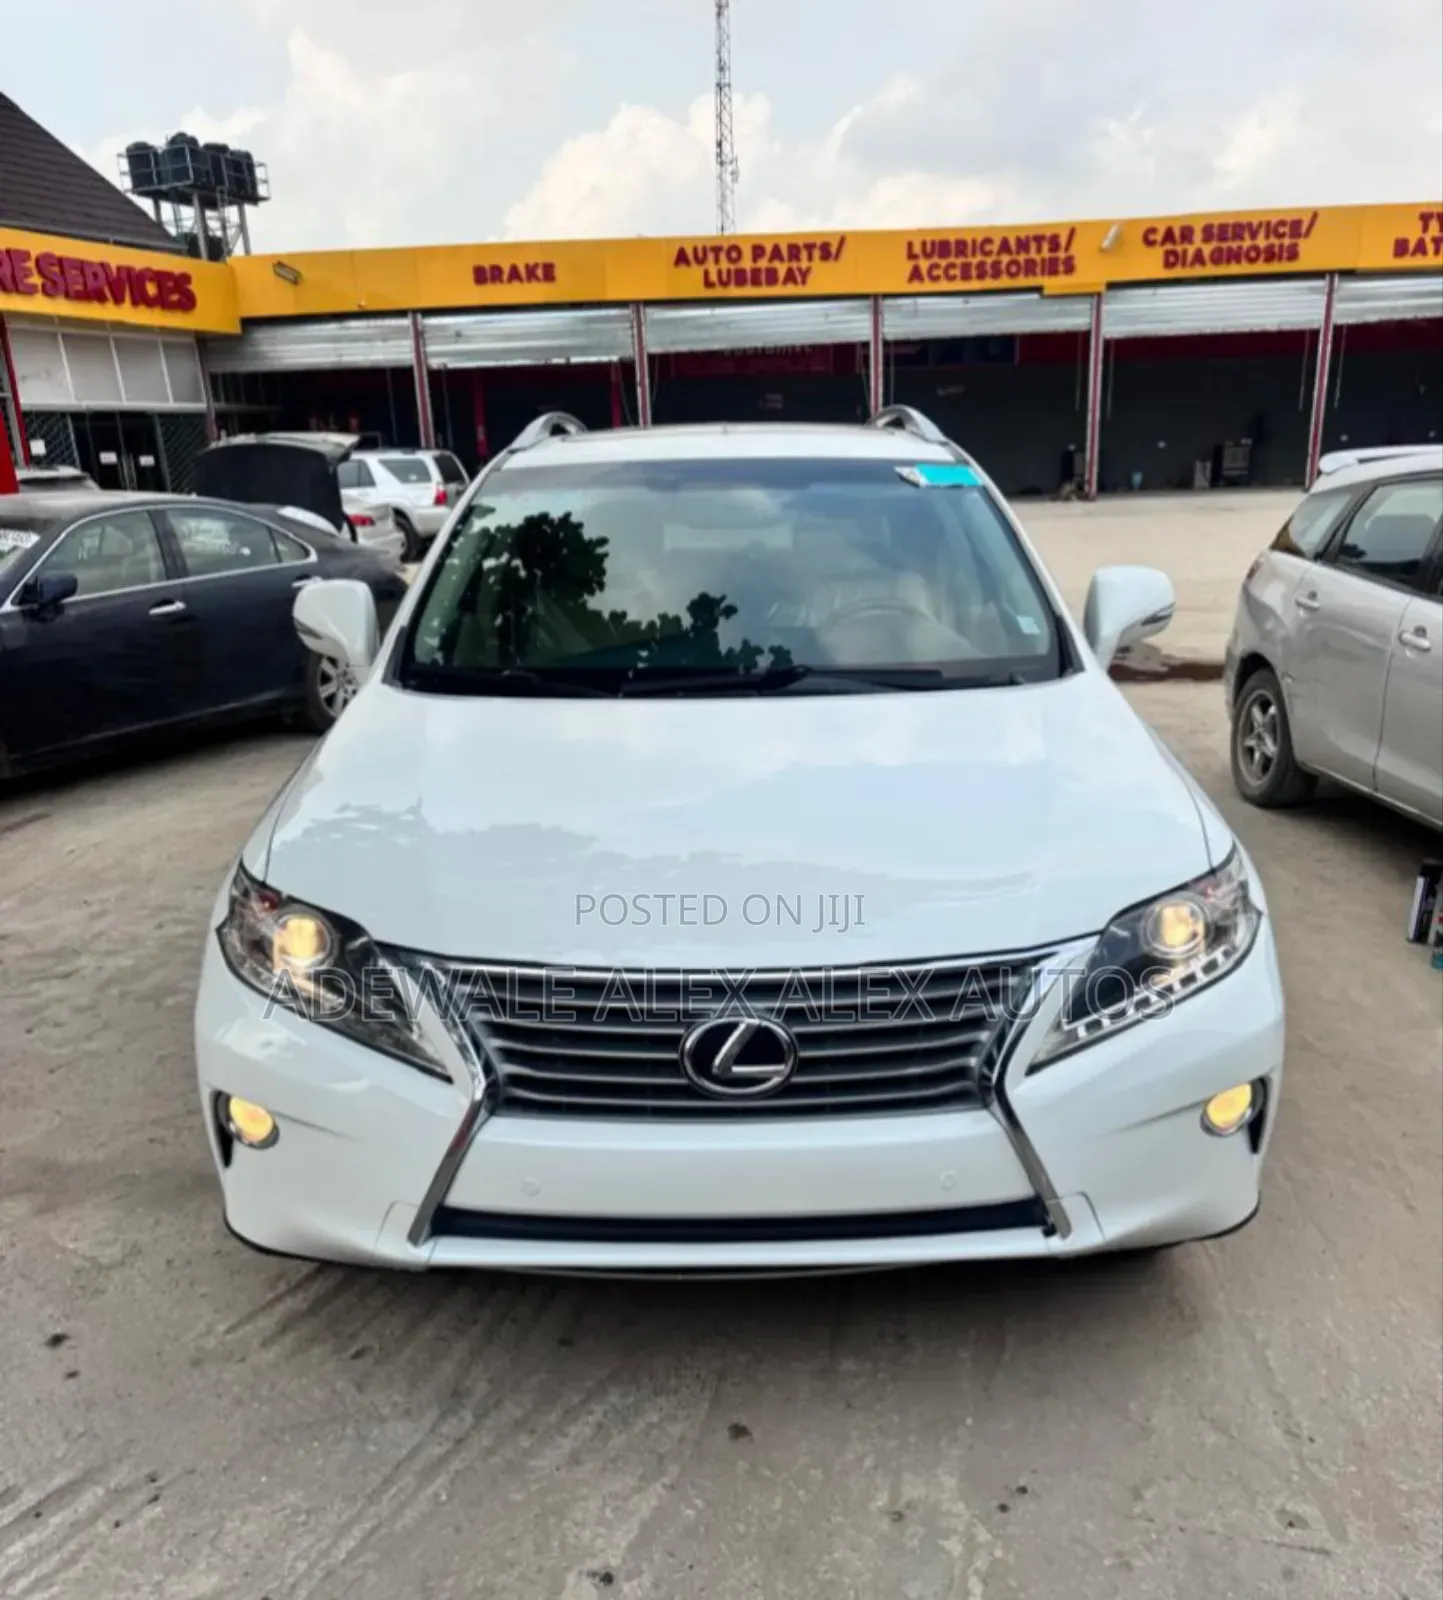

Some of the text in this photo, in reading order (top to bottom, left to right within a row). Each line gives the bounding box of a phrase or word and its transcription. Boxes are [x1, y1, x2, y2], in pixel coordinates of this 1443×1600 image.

[906, 226, 1077, 262] LUBRICANTS/
[1141, 211, 1319, 248] CAR SERVICE/
[673, 235, 847, 269] AUTO PARTS/
[1162, 241, 1300, 270] DIAGNOSIS
[35, 251, 197, 313] SERVICES
[472, 262, 557, 286] BRAKE
[703, 265, 812, 290] LUBEBAY
[907, 254, 1076, 284] ACCESSORIES
